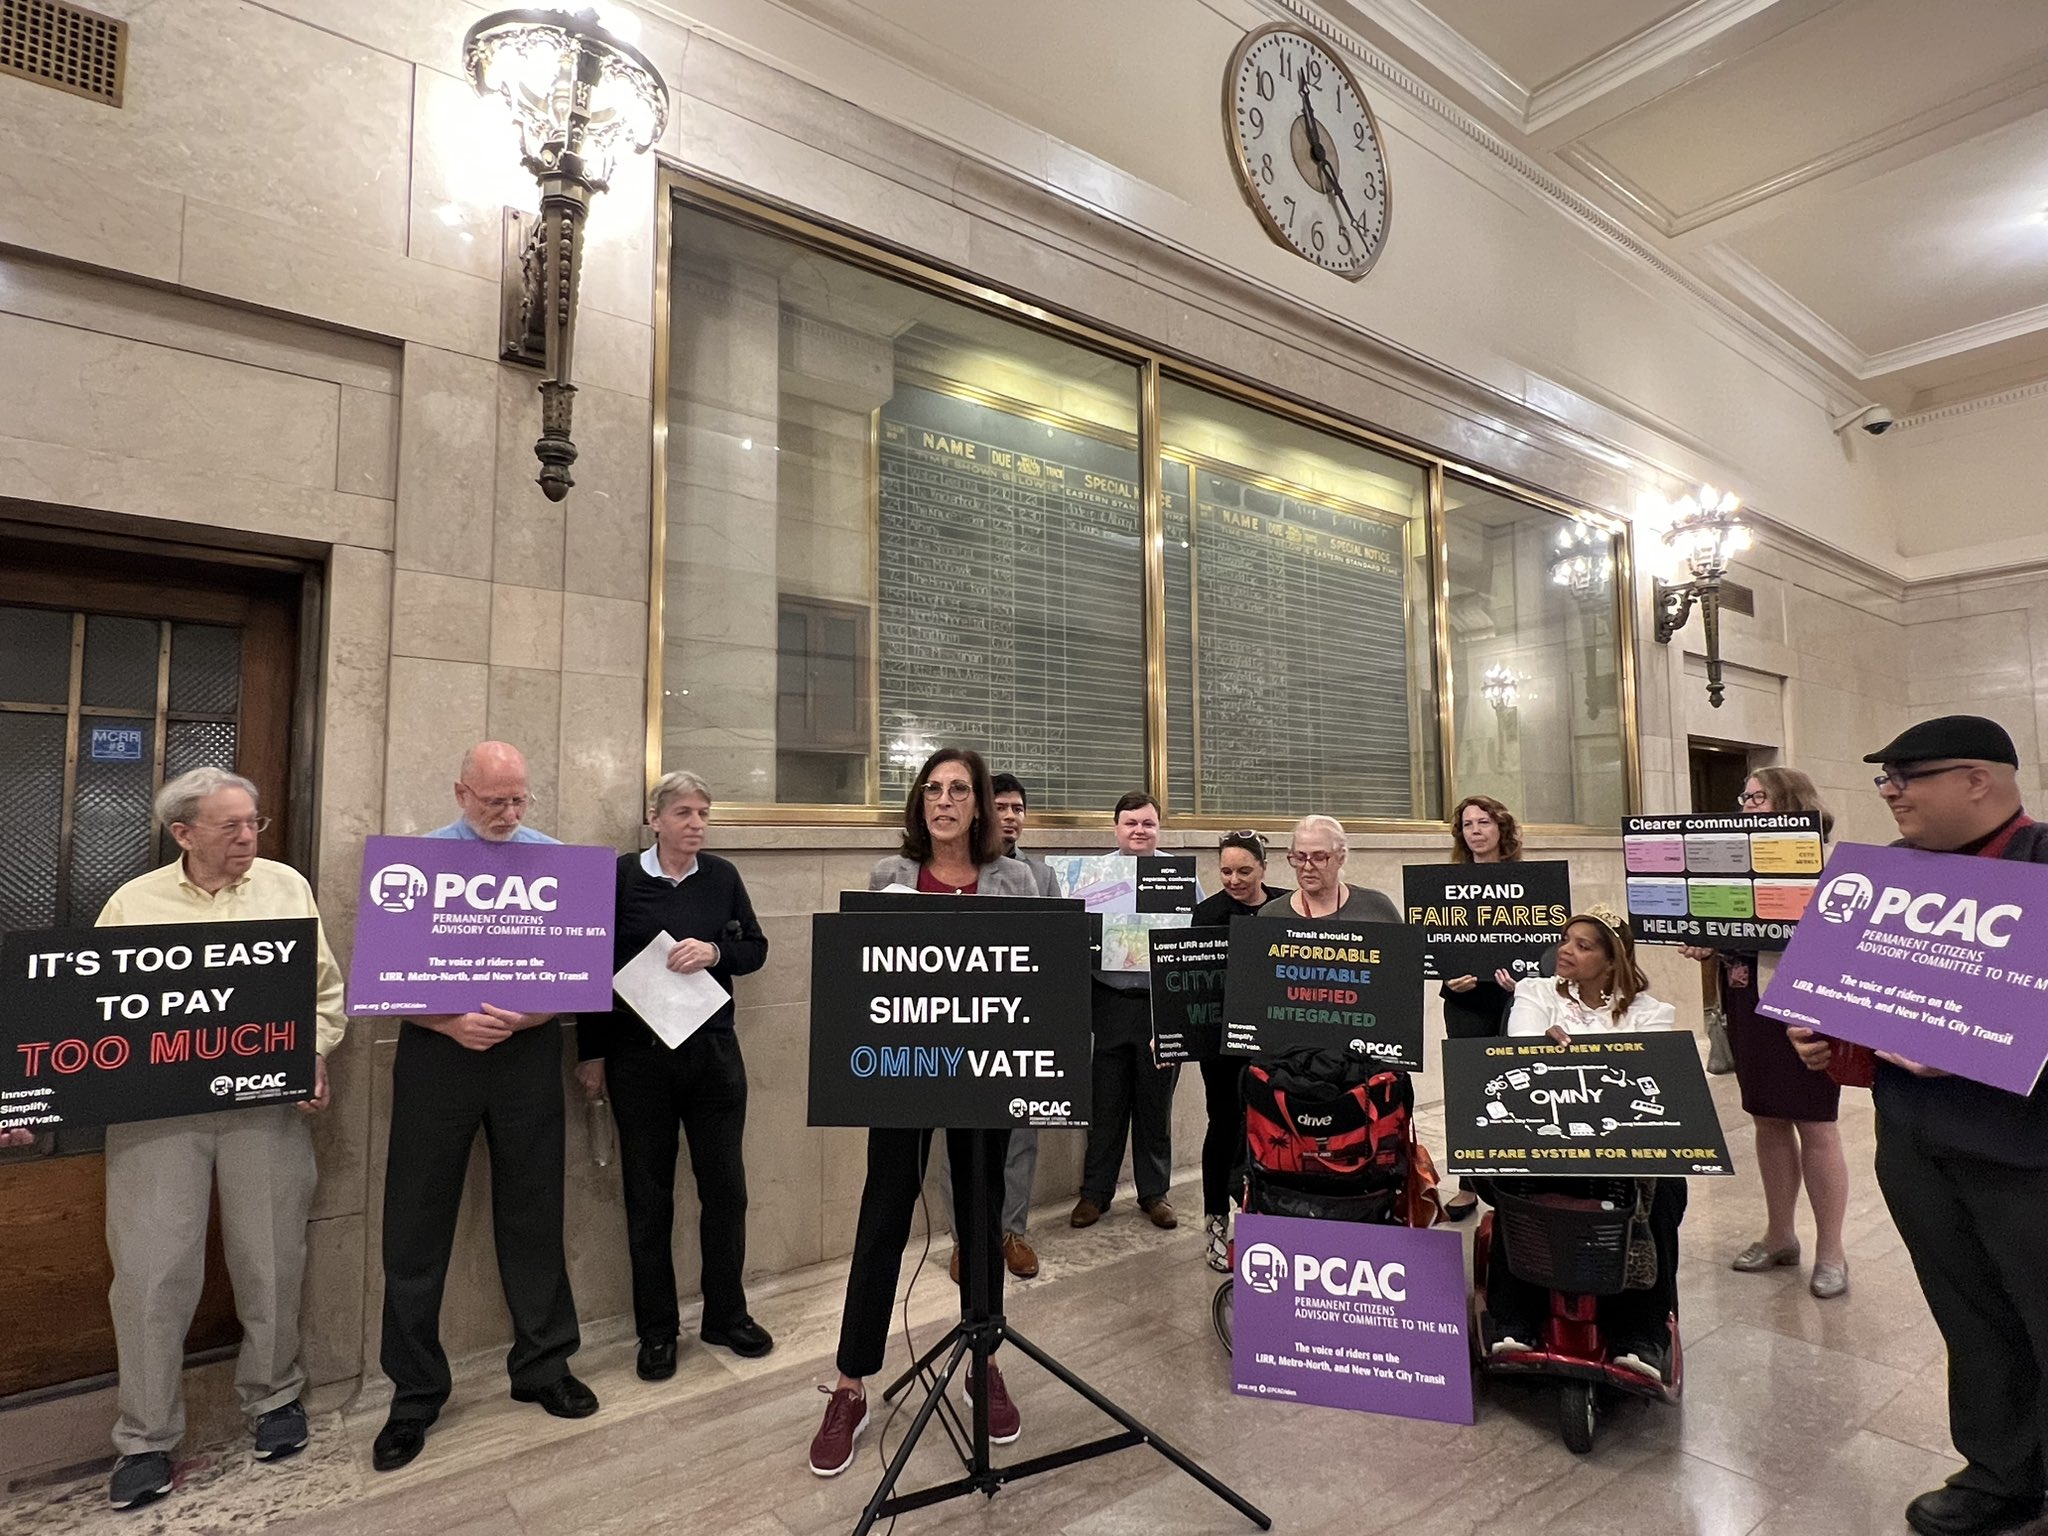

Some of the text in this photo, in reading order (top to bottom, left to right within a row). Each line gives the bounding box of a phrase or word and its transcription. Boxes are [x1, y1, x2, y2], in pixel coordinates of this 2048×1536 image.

[1280, 48, 1293, 82] 11
[1306, 56, 1323, 91] 12
[1256, 66, 1274, 101] 10
[1336, 85, 1342, 113] 1
[1249, 107, 1264, 139] 9
[1354, 122, 1365, 152] 2
[1262, 153, 1274, 185] 8
[1364, 171, 1377, 200] 3
[1284, 196, 1296, 228] 7
[1357, 209, 1370, 237] 4
[1311, 221, 1324, 251] 6
[1337, 226, 1350, 255] 5
[923, 432, 976, 459] NAME
[992, 450, 1012, 468] DUE
[1085, 475, 1131, 498] SPECIAL
[954, 460, 997, 478] SHOWN
[1002, 473, 1044, 488] BELOW
[1066, 488, 1109, 504] EASTERN
[1223, 510, 1259, 530] NAME
[1330, 539, 1362, 557] SPECIAL
[1364, 548, 1390, 564] NOTICE
[1345, 558, 1380, 572] STANDARD
[93, 731, 139, 742] MCRR
[109, 742, 125, 751] #8
[1629, 815, 1810, 831] Clearer communication
[434, 873, 557, 911] PCAC
[1445, 884, 1524, 900] EXPAND
[433, 914, 543, 925] PERMANENT CITIZENS
[1409, 905, 1567, 927] FAIR FARES
[1643, 919, 1700, 935] HELPS
[1870, 887, 2022, 947] PCAC
[432, 924, 606, 936] ADVISORY COMMITTEE TO THE MTA
[1286, 930, 1363, 942] Transit should be
[1427, 934, 1451, 942] LIRR
[1454, 934, 1477, 942] AND
[112, 946, 192, 973] TOO
[204, 940, 297, 968] EASY
[1154, 942, 1177, 950] Lower
[1179, 941, 1197, 949] LIRR
[1268, 944, 1381, 964] AFFORDABLE
[1862, 929, 1985, 963] PERMANENT CITIZENS
[429, 957, 446, 966] The
[449, 957, 472, 966] voice
[475, 957, 485, 966] of
[487, 957, 514, 966] riders
[530, 958, 544, 966] the
[862, 946, 1039, 973] INNOVATE.
[1183, 954, 1215, 962] transfers
[1856, 941, 2032, 986] ADVISORY COMMITTEE TO THE
[408, 972, 470, 982] Metro-North,
[472, 972, 490, 981] and
[493, 972, 512, 981] New
[516, 972, 536, 981] York
[539, 972, 555, 982] City
[559, 972, 589, 981] Transit
[1275, 965, 1371, 984] EQUITABLE
[96, 988, 234, 1020] TO PAY
[1287, 987, 1358, 1005] UNIFIED
[1841, 974, 1962, 1013] The voice of riders on the
[870, 997, 1030, 1023] SIMPLIFY.
[1267, 1006, 1376, 1027] INTEGRATED
[1815, 984, 1872, 1009] Metro-North,
[1875, 1000, 1894, 1013] and
[1895, 1006, 1919, 1020] New
[1921, 1011, 1945, 1027] York
[1949, 1019, 1971, 1035] City
[1972, 1025, 2014, 1045] Transit
[17, 1021, 296, 1077] TOO MUCH
[1366, 1043, 1402, 1056] PCAC
[1486, 1042, 1645, 1056] ONE METRO NEW YORK
[235, 1072, 286, 1091] PCAC
[1, 1088, 55, 1099] Innovate.
[1530, 1088, 1603, 1104] OMNY
[0, 1102, 51, 1114] Simplify.
[1029, 1101, 1071, 1116] PCAC
[0, 1115, 63, 1128] OMNYvate.
[1298, 1113, 1332, 1126] drive
[1454, 1148, 1718, 1160] ONE FARE SYSTEM FOR NEW YORK
[1294, 1254, 1406, 1301] PCAC
[1295, 1297, 1395, 1316] PERMANENT CITIZENS
[1295, 1308, 1459, 1335] ADVISORY COMMITTEE TO THE MTA
[1295, 1342, 1309, 1353] The
[1312, 1344, 1333, 1357] voice
[1335, 1347, 1344, 1357] of
[1346, 1348, 1370, 1360] riders
[1385, 1353, 1399, 1364] the
[1256, 1353, 1445, 1385] LIRR, Metro-North, and New York City Transit
